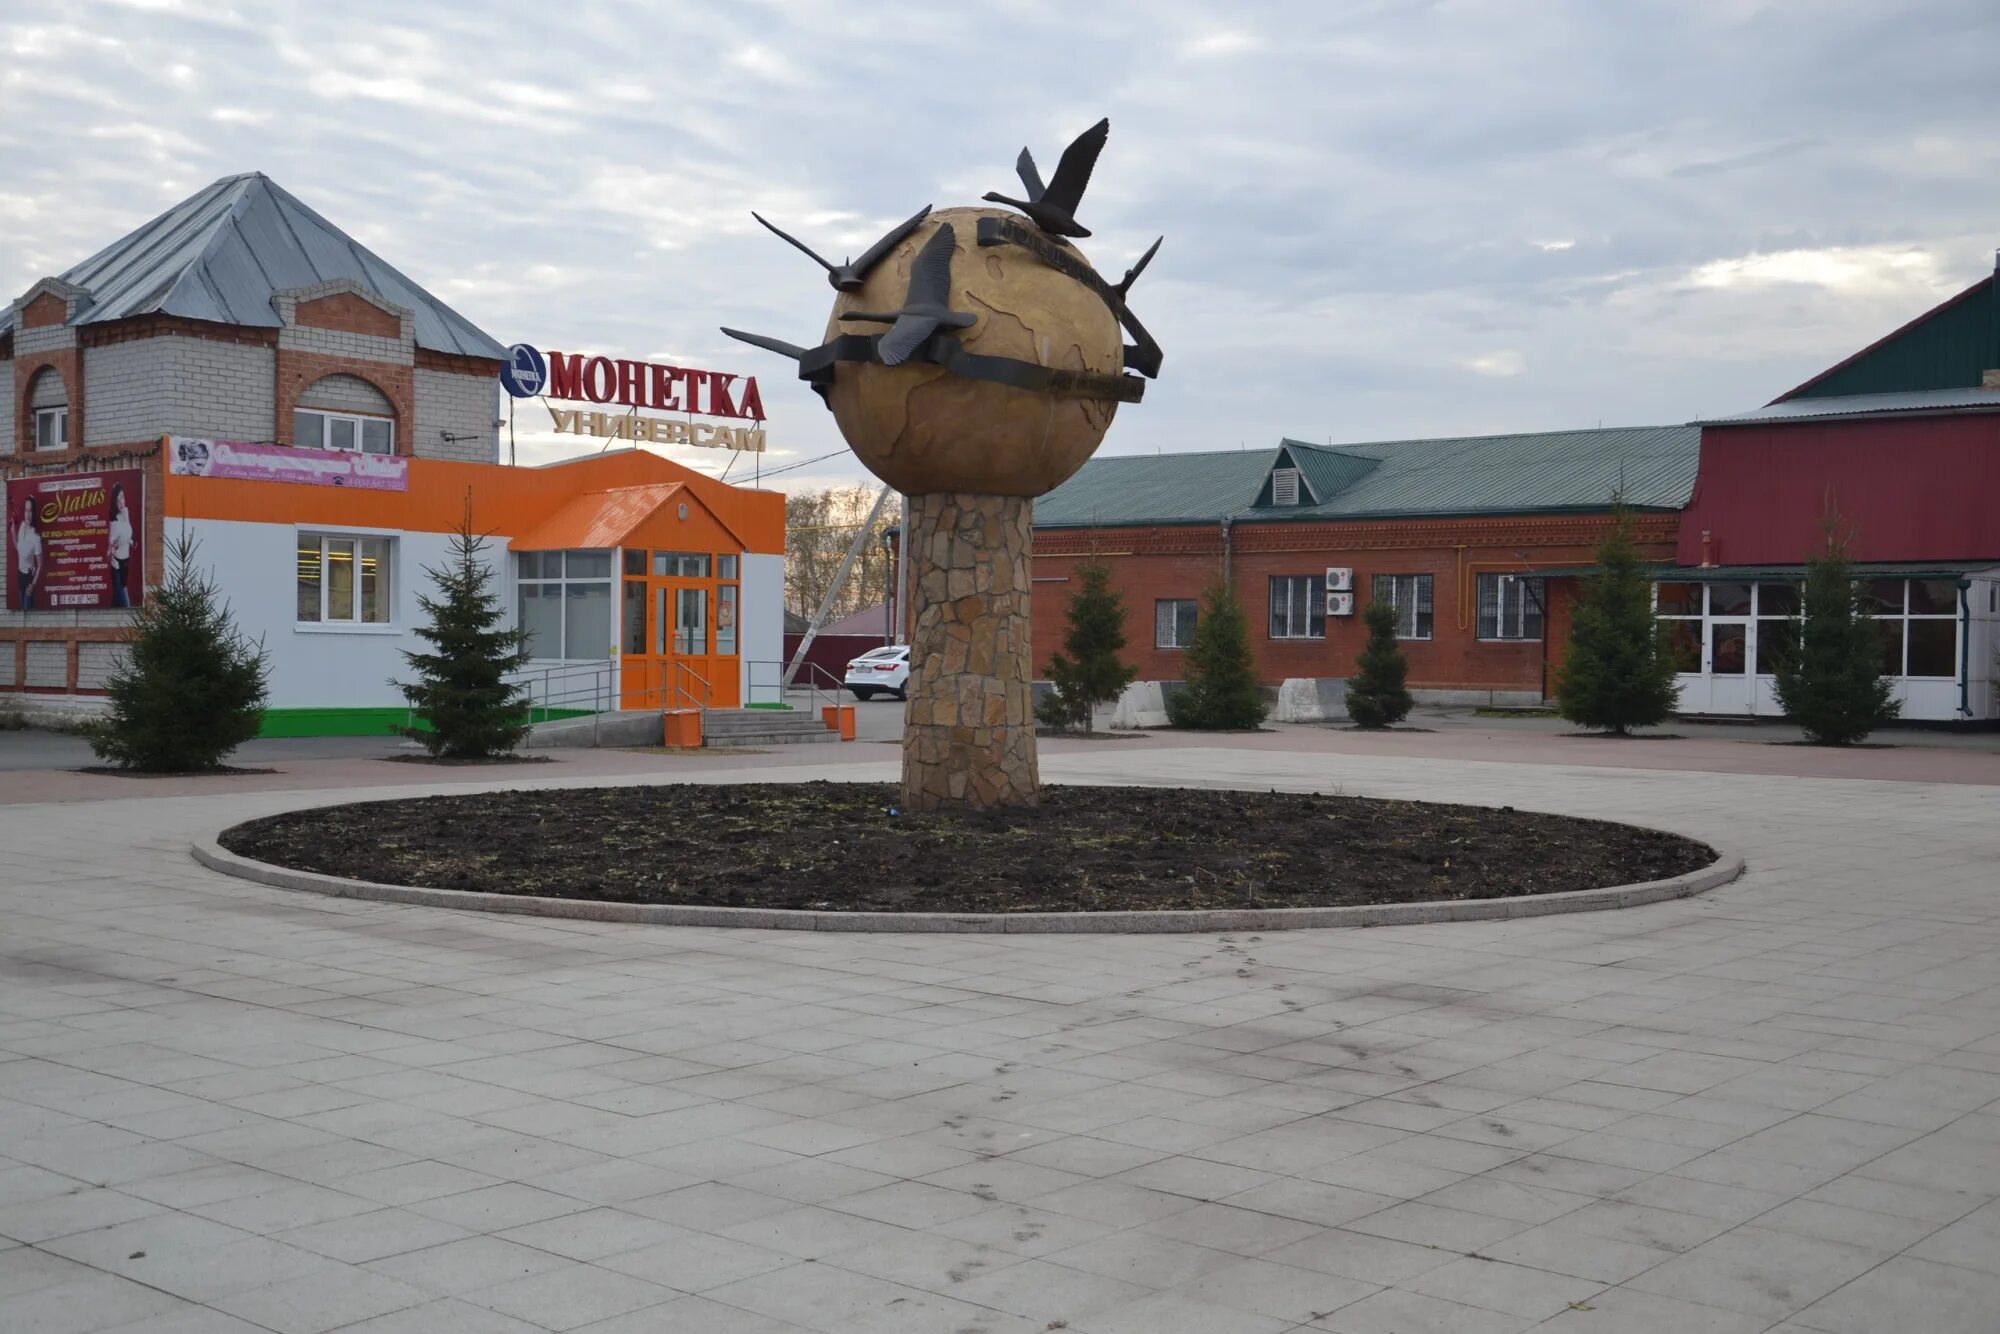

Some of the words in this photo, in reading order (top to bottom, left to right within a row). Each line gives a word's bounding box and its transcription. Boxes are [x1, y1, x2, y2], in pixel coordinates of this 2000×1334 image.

[512, 368, 541, 383] МОНЕТКА
[547, 351, 767, 420] МОНЕТКА
[549, 408, 767, 452] УНИВЕРСАМ
[40, 487, 106, 523] Status
